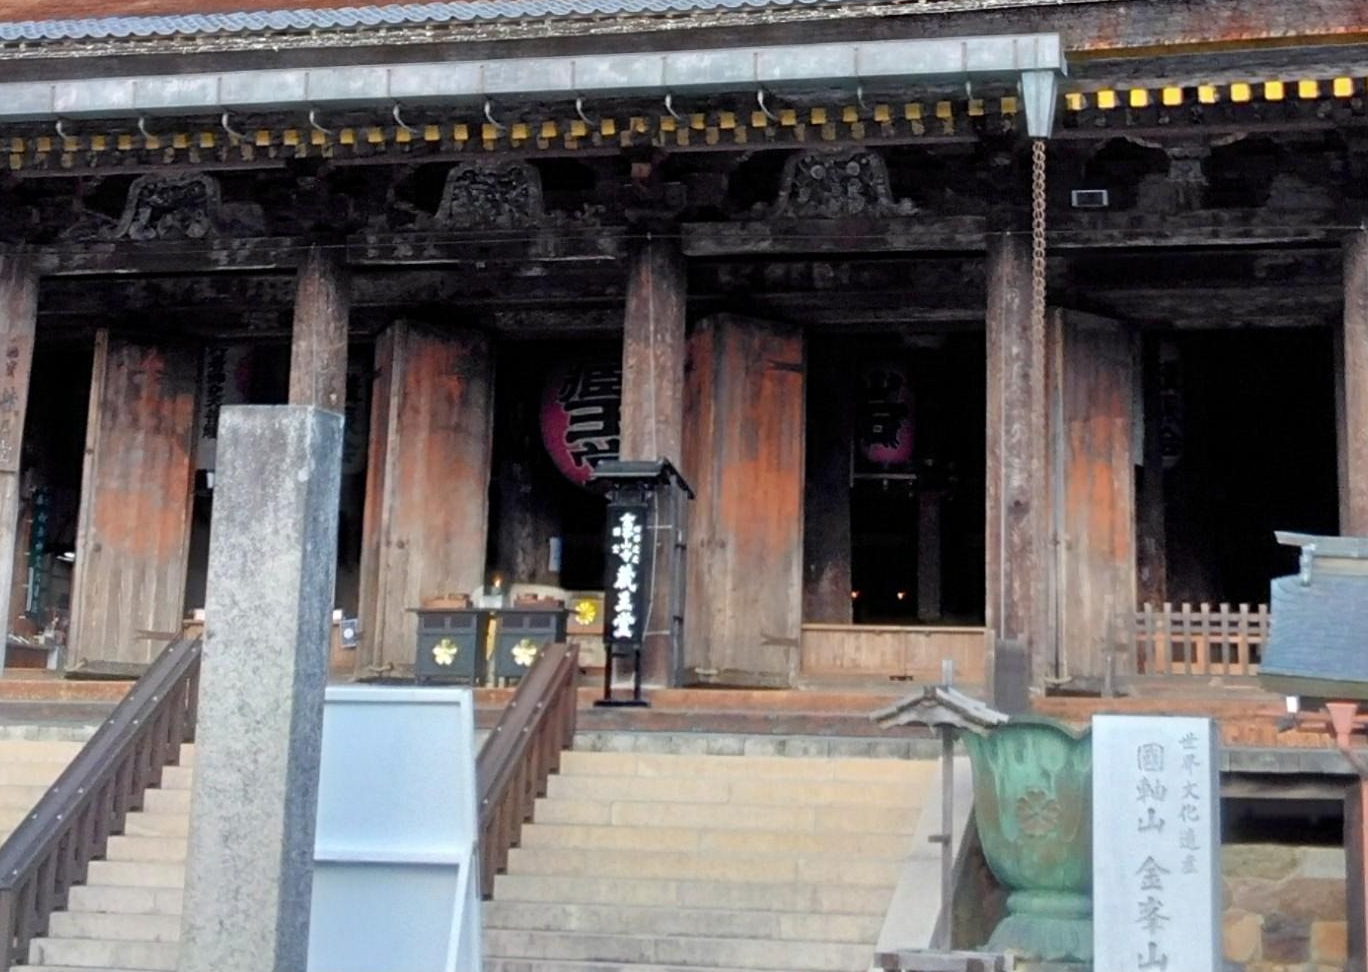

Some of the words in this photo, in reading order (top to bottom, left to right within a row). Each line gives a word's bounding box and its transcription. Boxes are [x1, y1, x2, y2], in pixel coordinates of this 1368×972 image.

[1135, 742, 1168, 835] 國軸山
[1178, 731, 1202, 875] 世界文化遺産
